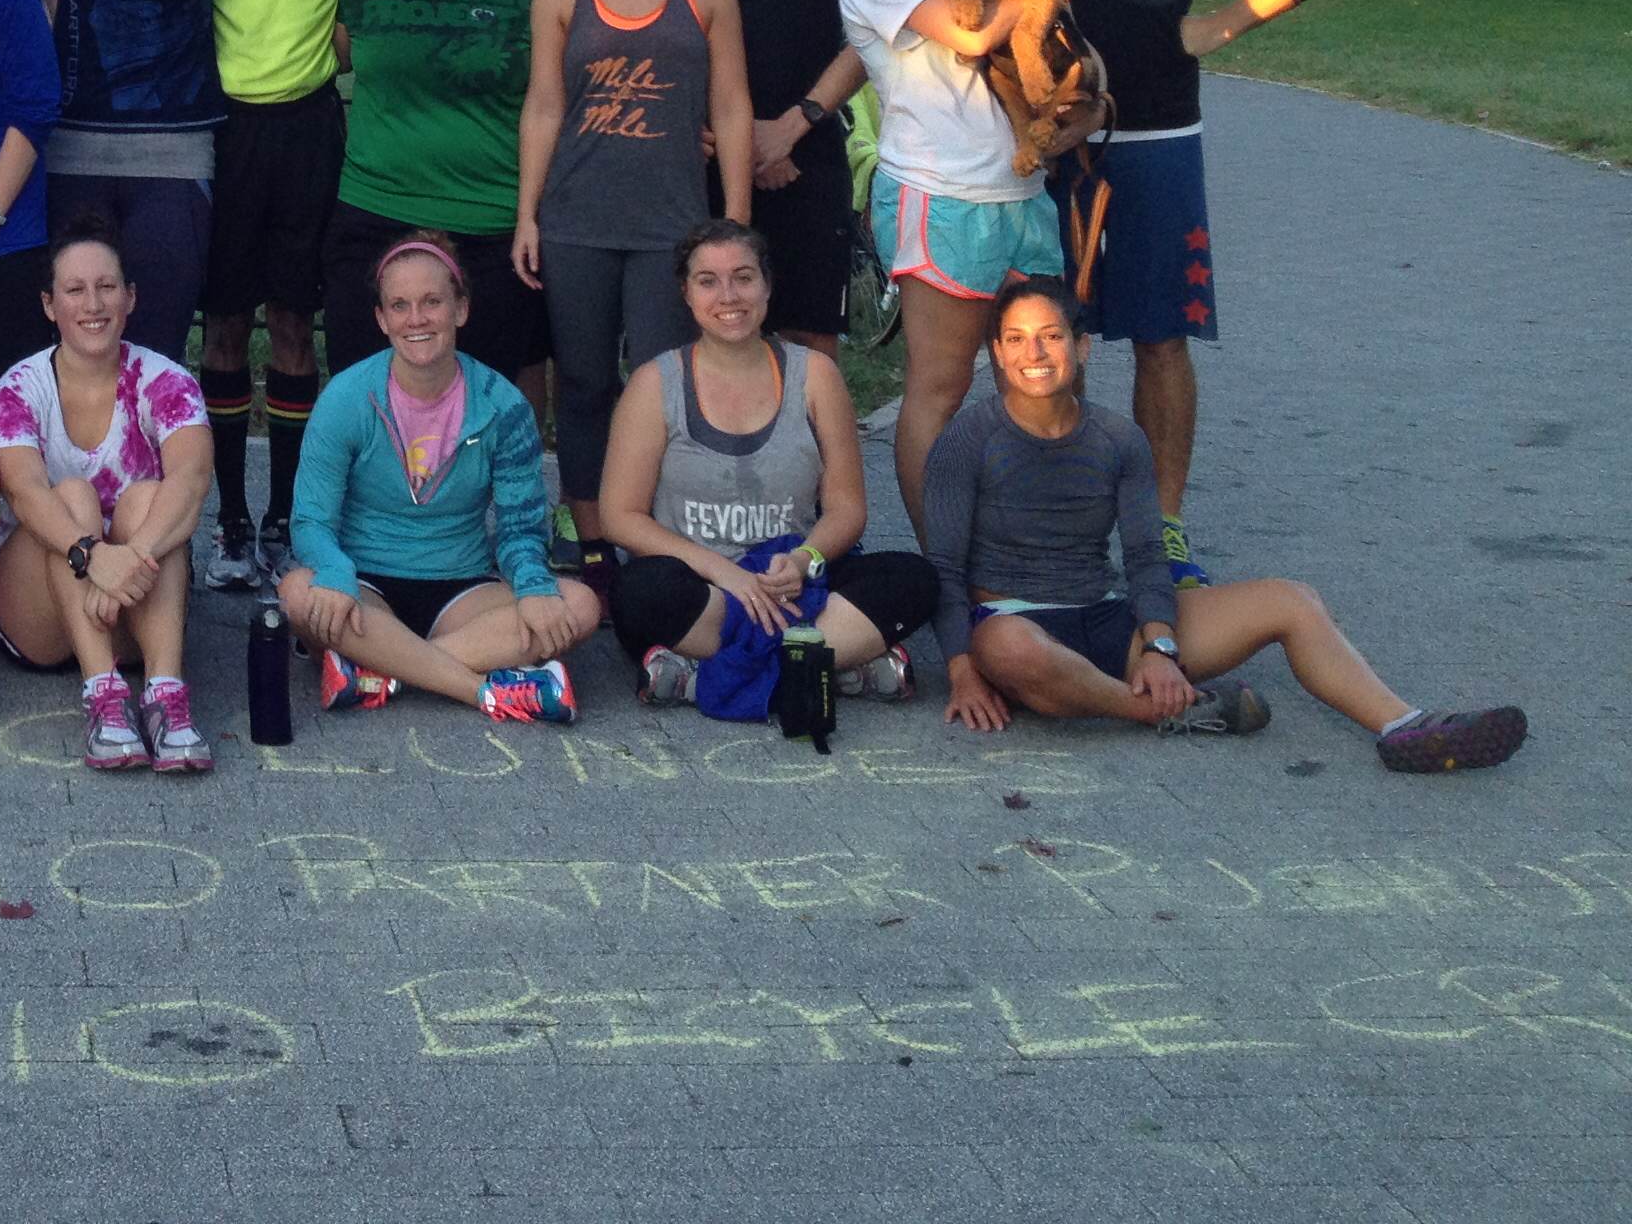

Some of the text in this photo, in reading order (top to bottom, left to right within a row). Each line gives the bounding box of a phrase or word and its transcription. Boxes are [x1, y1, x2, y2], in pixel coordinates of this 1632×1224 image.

[585, 56, 677, 89] Mile
[577, 104, 668, 138] Mile
[11, 997, 296, 1085] 10
